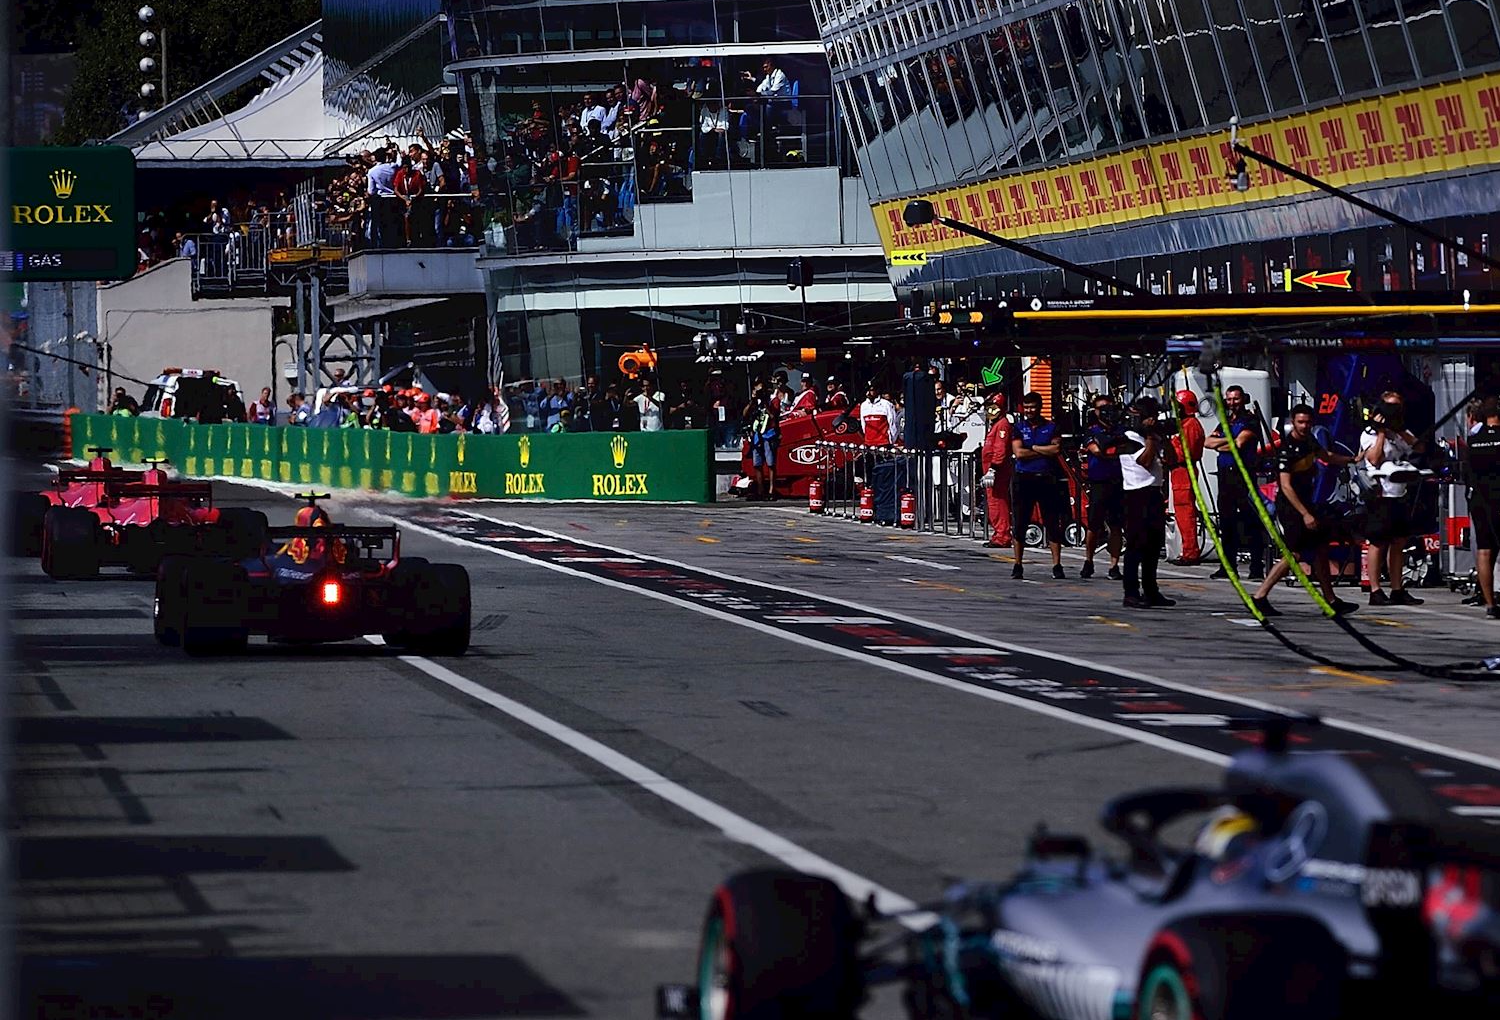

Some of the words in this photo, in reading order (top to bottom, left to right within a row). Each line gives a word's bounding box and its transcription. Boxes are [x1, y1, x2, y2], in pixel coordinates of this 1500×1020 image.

[12, 205, 112, 224] ROLEX
[28, 254, 62, 267] GAS
[1289, 338, 1343, 347] WILLIAMS
[505, 473, 545, 494] ROLEX
[592, 474, 648, 495] ROLEX
